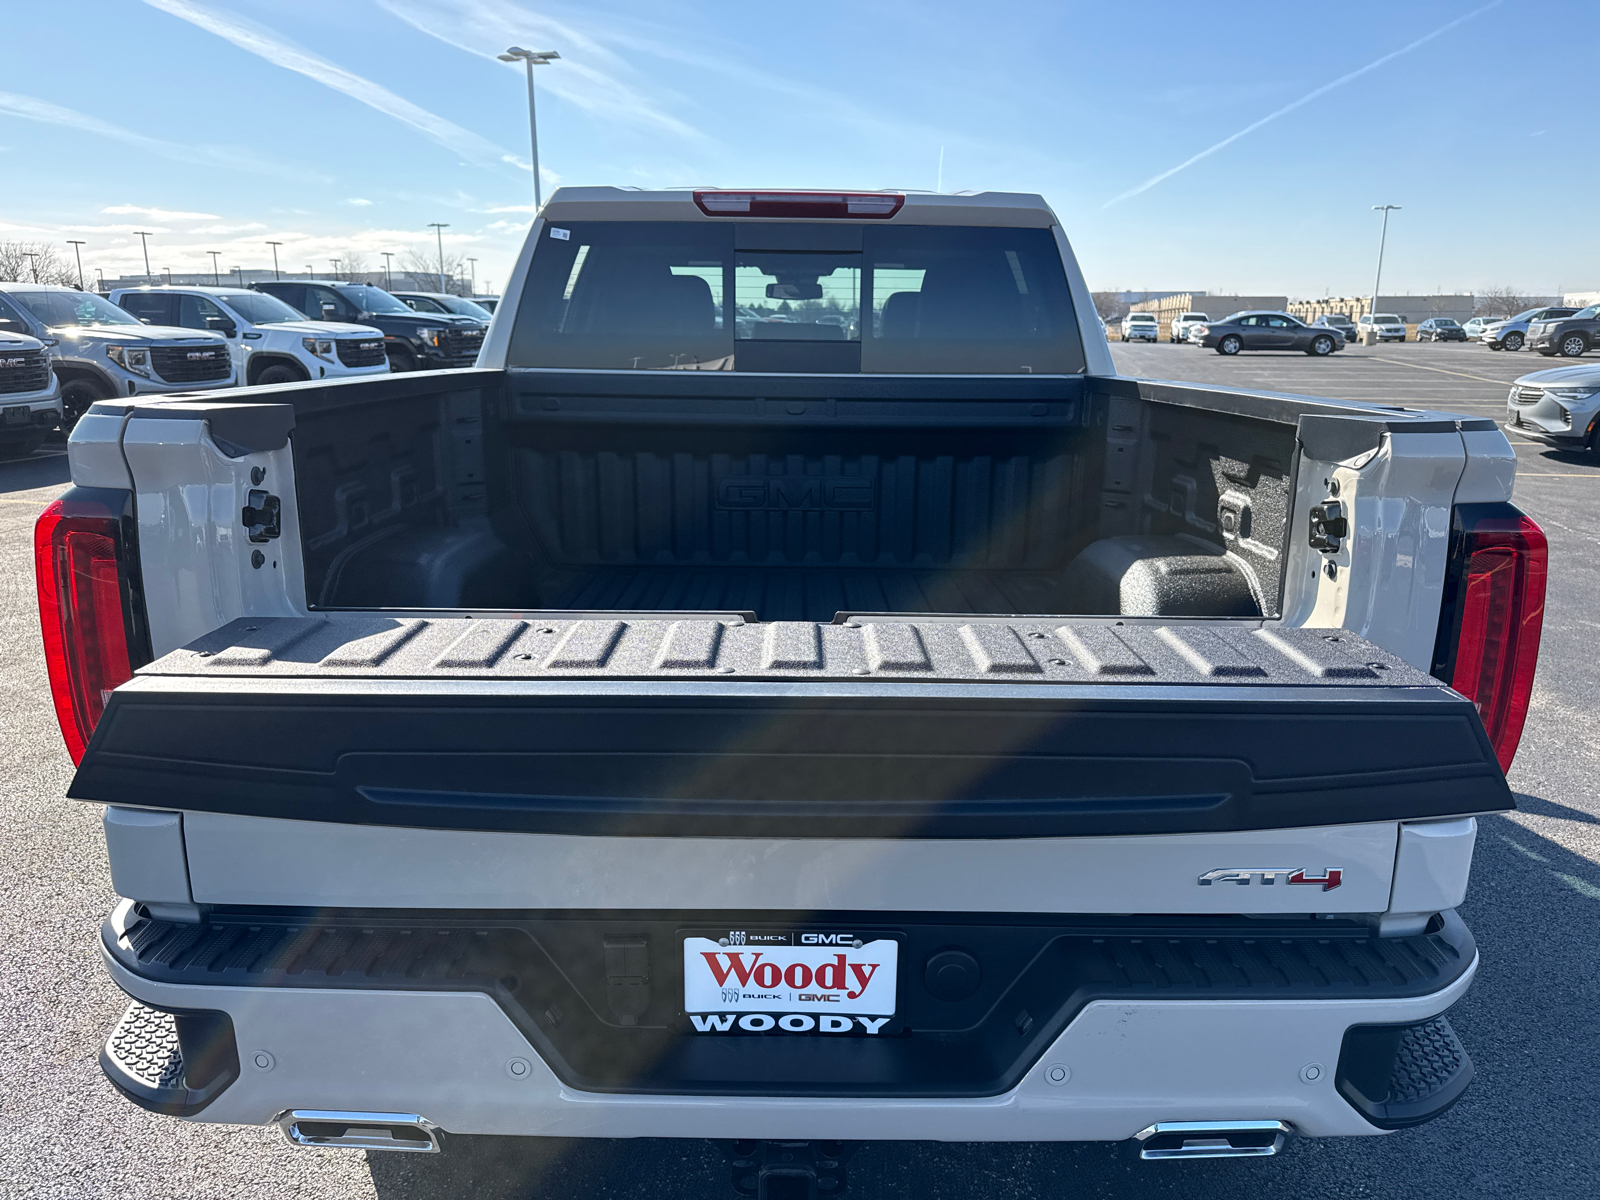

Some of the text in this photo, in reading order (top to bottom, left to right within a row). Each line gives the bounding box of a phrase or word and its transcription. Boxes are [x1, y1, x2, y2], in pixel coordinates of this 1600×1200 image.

[0, 357, 26, 368] MC
[187, 351, 216, 360] GMC
[717, 479, 873, 508] GMC
[1198, 867, 1344, 892] AT4
[801, 933, 854, 944] GMC
[700, 952, 880, 1000] Woody
[798, 993, 841, 1003] GMC
[689, 1013, 891, 1035] WOODY
